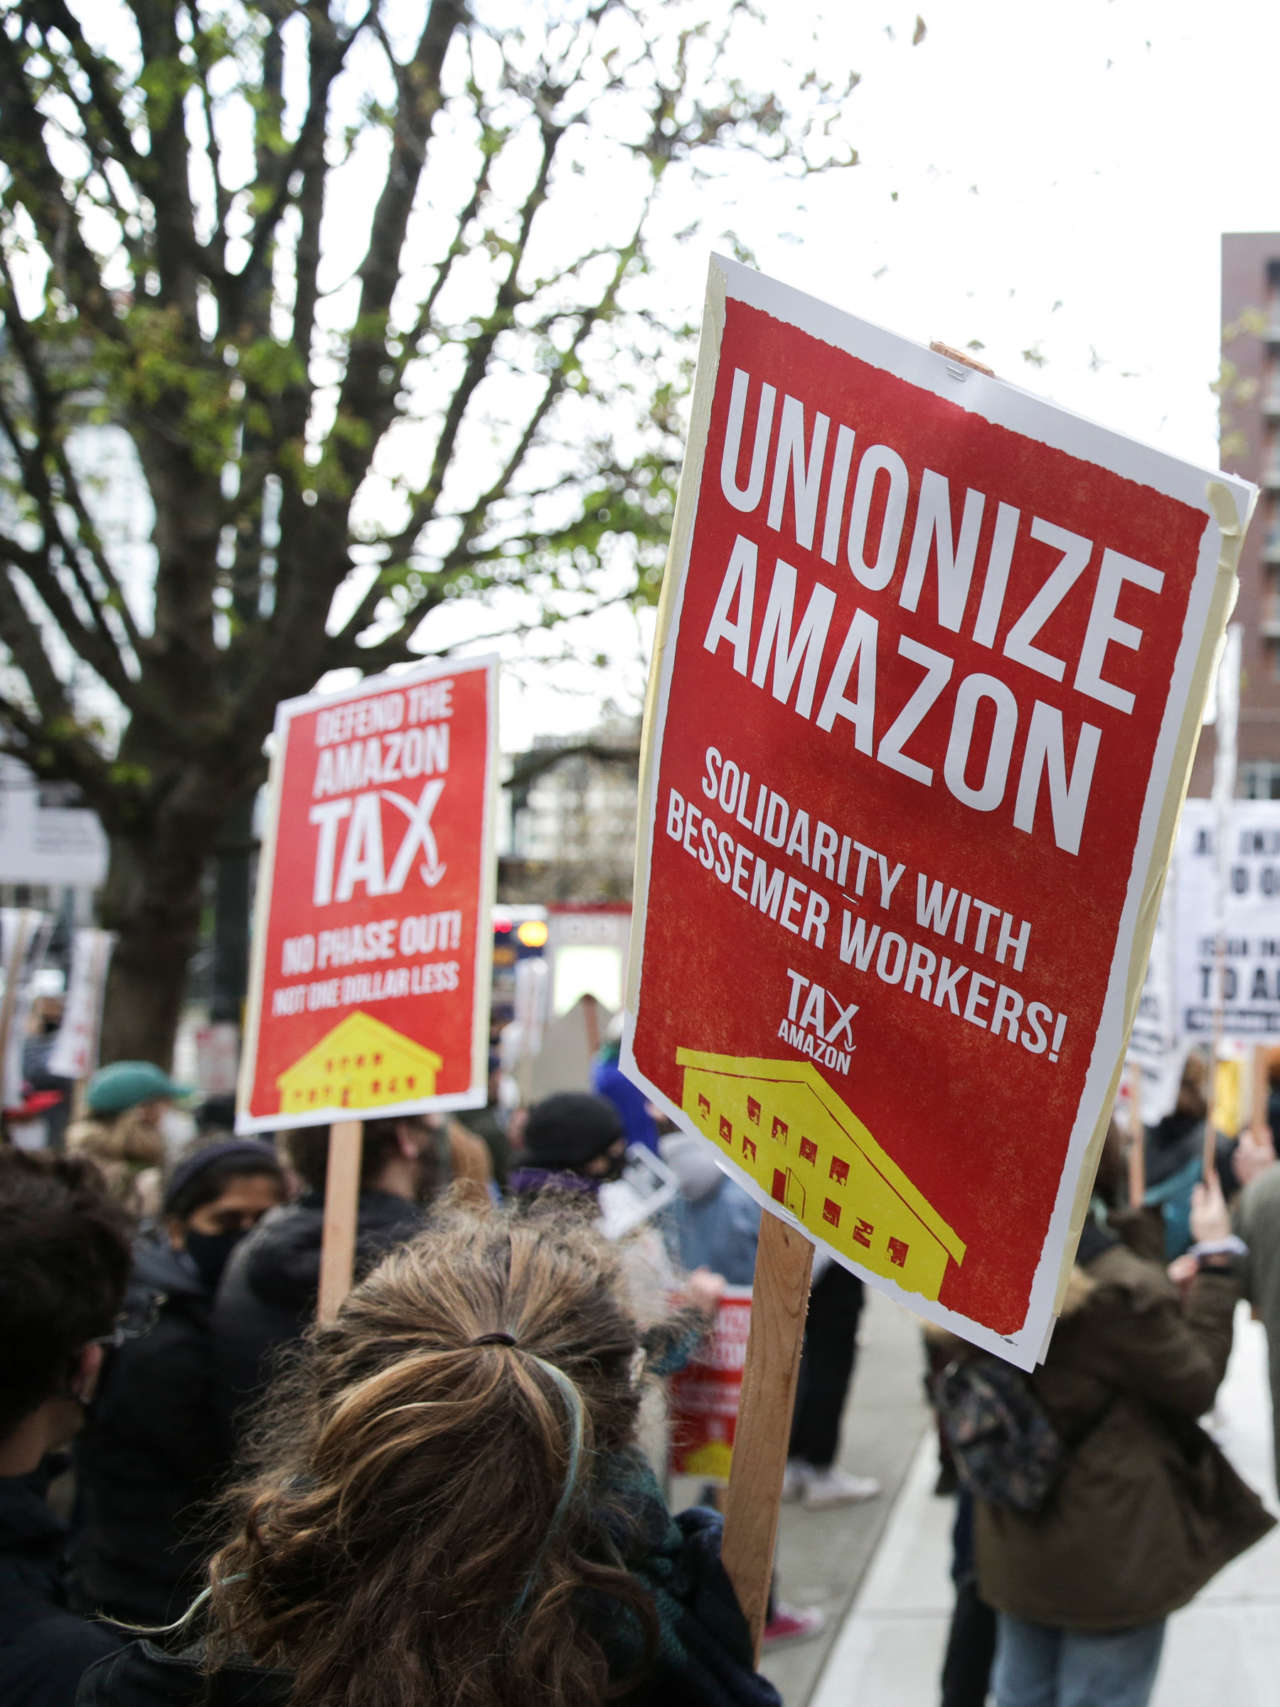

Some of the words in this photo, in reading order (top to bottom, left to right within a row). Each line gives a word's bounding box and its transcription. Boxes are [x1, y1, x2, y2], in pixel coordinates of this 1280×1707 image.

[720, 367, 1165, 715] UNIONIZE
[314, 692, 405, 748] DEFEND
[407, 679, 455, 725] THE
[703, 534, 1102, 856] AMAZON
[313, 723, 449, 799] AMAZON
[308, 778, 447, 907] TAX
[702, 746, 906, 910] SOLIDARITY
[916, 873, 1032, 973] WITH
[282, 933, 316, 977] NO
[317, 919, 398, 970] PHASE
[400, 909, 462, 956] OUT!
[666, 788, 831, 949] BESSEMER
[839, 909, 1068, 1063] WORKERS!
[272, 985, 305, 1018] NOT
[307, 977, 340, 1012] ONE
[411, 961, 460, 996] LESS
[787, 968, 859, 1052] TAX
[778, 1018, 852, 1076] AMAZON
